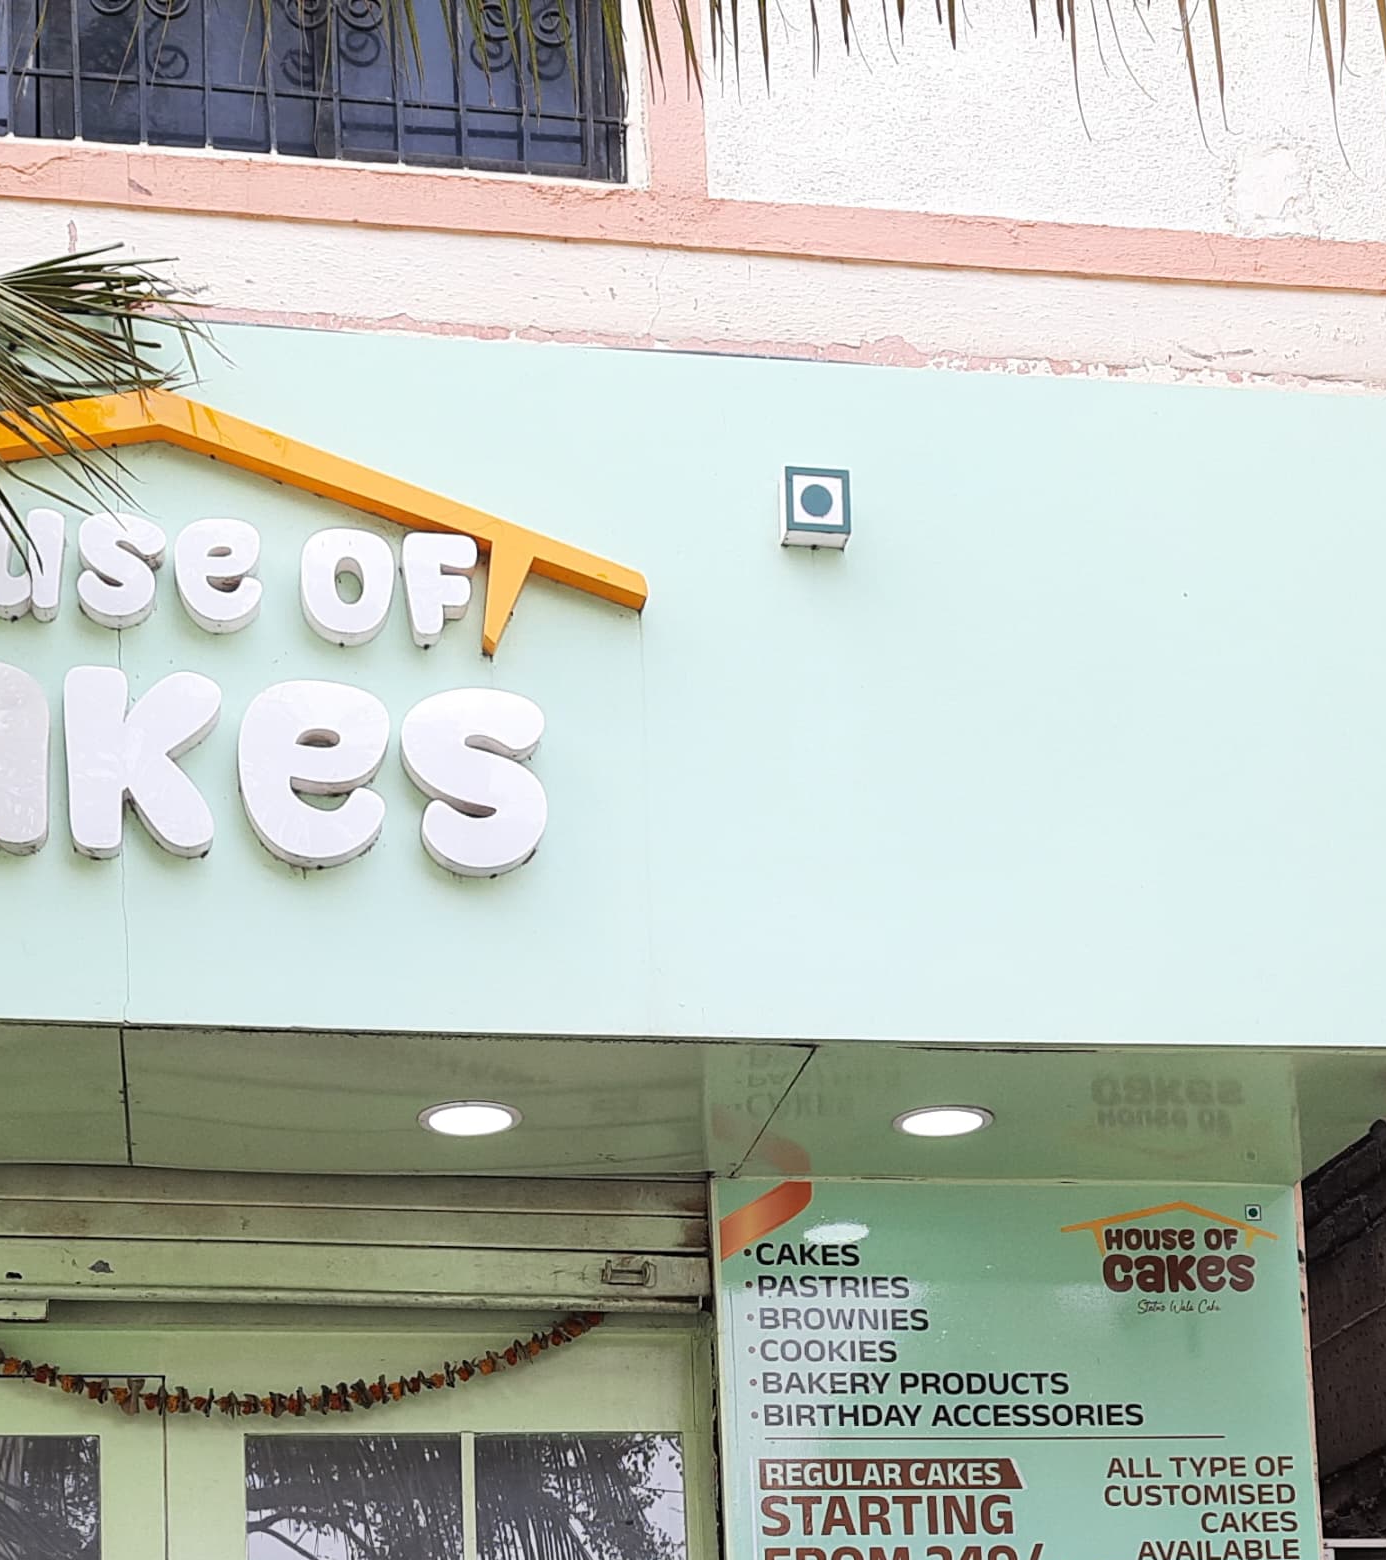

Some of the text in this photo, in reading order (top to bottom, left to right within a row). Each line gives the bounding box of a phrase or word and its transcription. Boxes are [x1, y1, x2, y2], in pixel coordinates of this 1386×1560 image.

[755, 1242, 860, 1267] CAKES
[758, 1275, 910, 1299] PASTRIES
[759, 1307, 929, 1332] BROWNIES
[760, 1339, 897, 1363] COOKIES
[762, 1371, 1070, 1395] BAKERY PRODUCTS
[764, 1403, 1145, 1428] BIRTHDAY ACCESSORIES
[765, 1462, 1001, 1487] REGULAR CAKES
[1106, 1456, 1294, 1478] ALL TYPE OF
[1104, 1484, 1296, 1506] CUSTOMISED
[761, 1494, 1014, 1537] STARTING
[1200, 1511, 1298, 1533] CAKES
